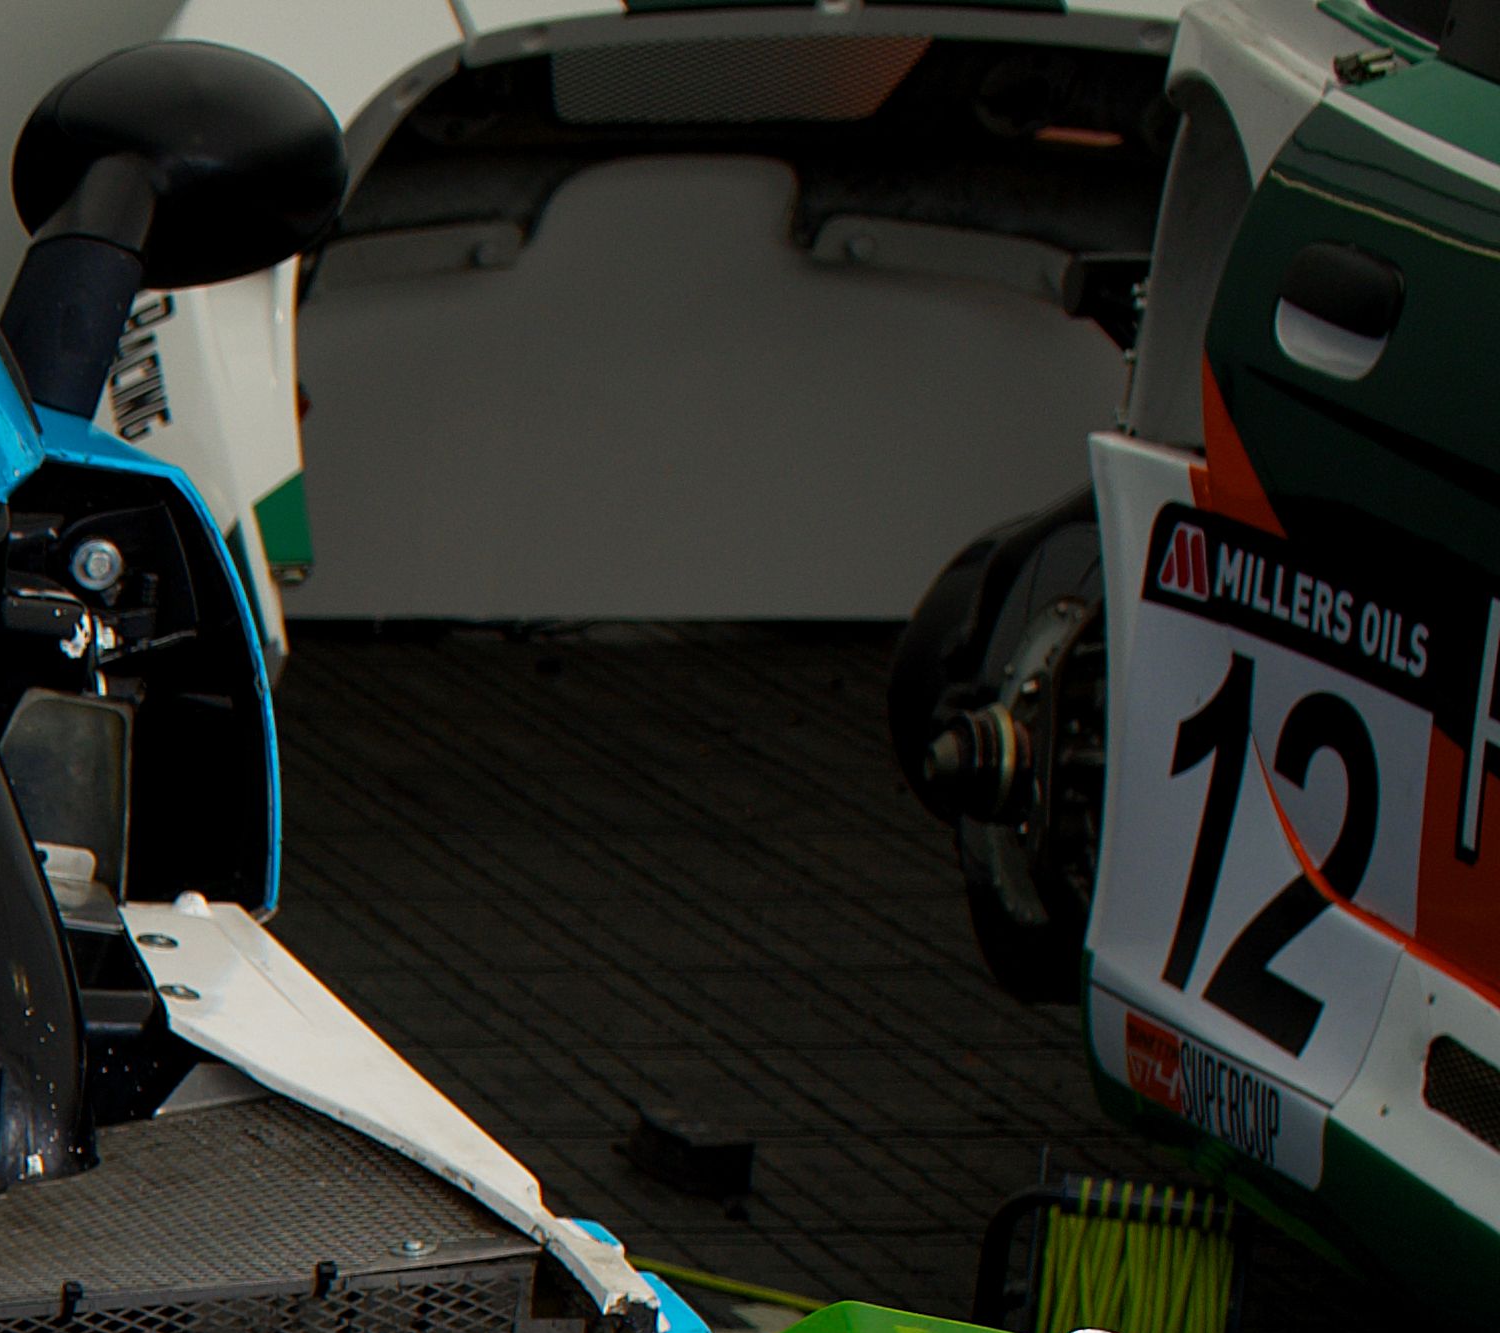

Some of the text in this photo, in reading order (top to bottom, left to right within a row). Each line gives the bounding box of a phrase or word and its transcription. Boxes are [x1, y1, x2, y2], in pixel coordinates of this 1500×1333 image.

[1213, 540, 1431, 679] MILLERS OILS
[1161, 651, 1380, 1058] 12
[1180, 1040, 1280, 1165] SUPERCUP
